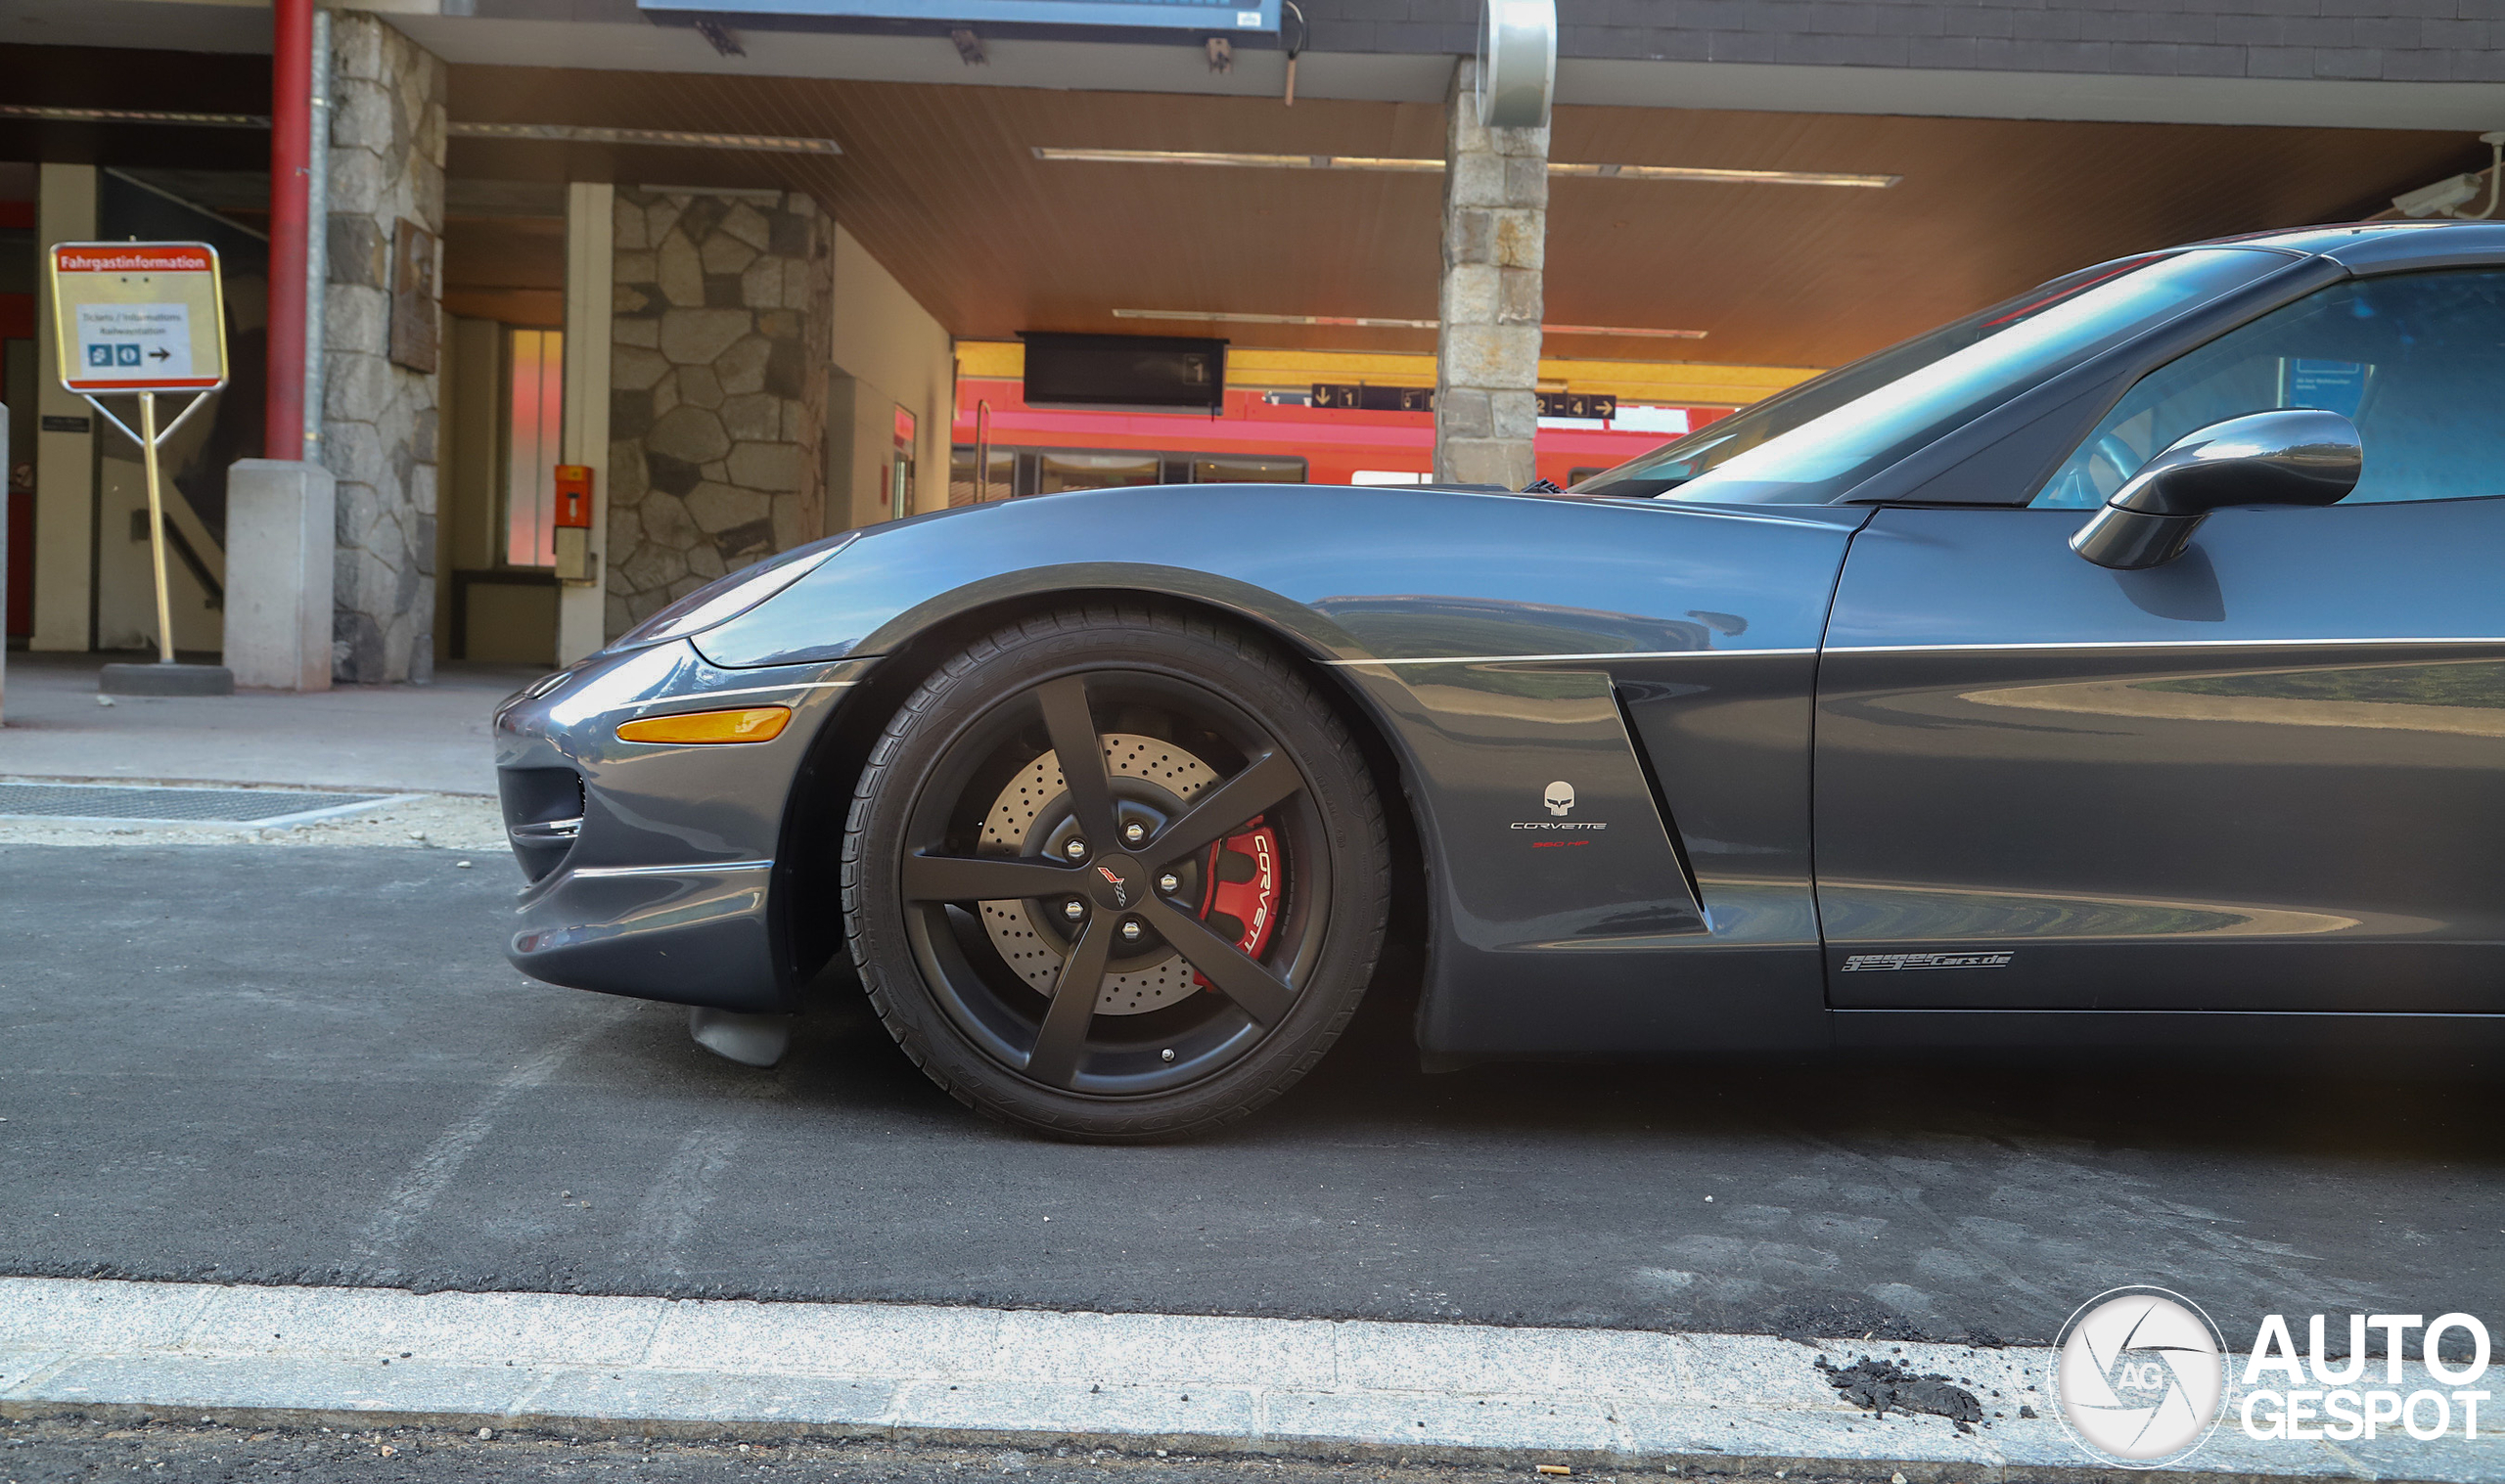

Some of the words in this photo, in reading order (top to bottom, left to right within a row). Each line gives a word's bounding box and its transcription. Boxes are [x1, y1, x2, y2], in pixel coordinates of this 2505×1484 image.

[61, 255, 205, 271] Fahrgastinformation
[1345, 392, 1352, 406] 1
[1572, 401, 1583, 414] 4
[974, 633, 1158, 684] EAGLE
[1244, 834, 1271, 955] CORVETT
[950, 1063, 1273, 1132] GOODYEAR
